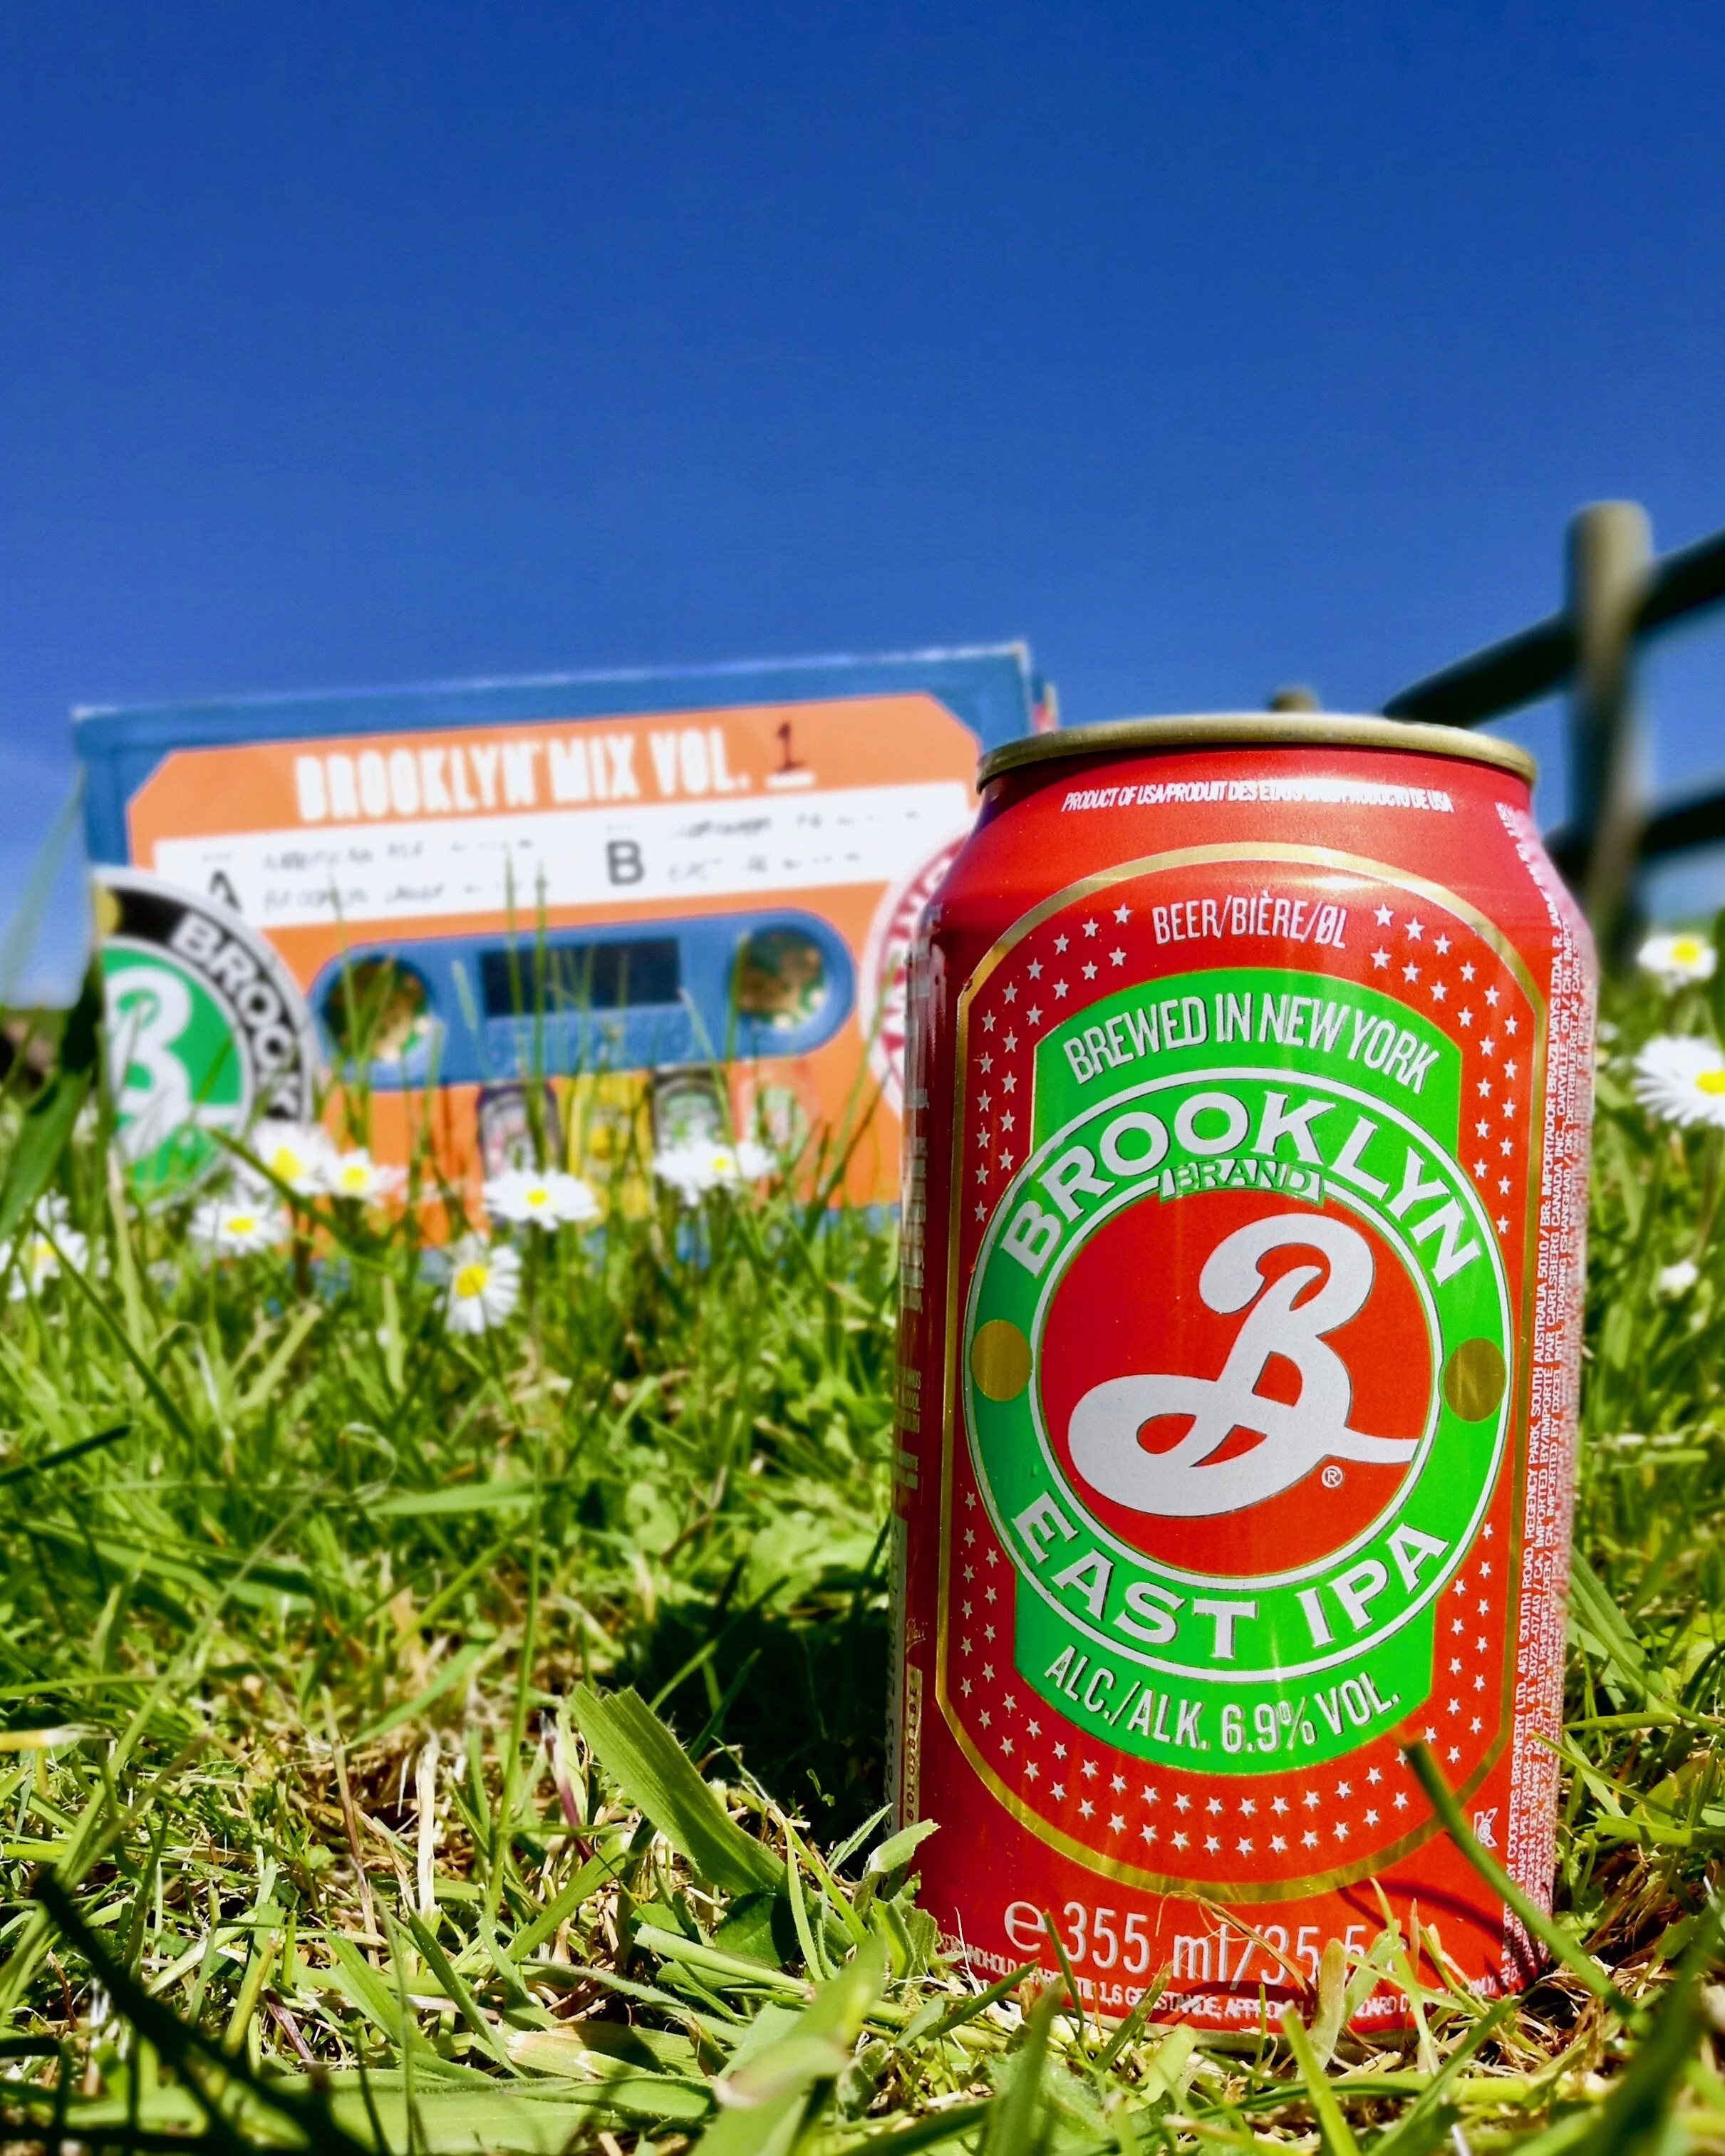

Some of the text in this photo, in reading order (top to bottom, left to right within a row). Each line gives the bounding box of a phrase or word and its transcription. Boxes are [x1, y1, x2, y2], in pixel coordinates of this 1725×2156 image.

[294, 738, 538, 822] BROOKLYN
[546, 731, 641, 805] MIX
[649, 725, 751, 797] VOL.
[1060, 787, 1120, 812] PRODUCT
[1118, 785, 1139, 807] OF
[605, 839, 644, 886] B
[1151, 889, 1347, 949] BEER/BIÈRE/ØL
[1062, 992, 1441, 1094] BREWED IN NEW YORK
[1560, 1008, 1571, 1034] ON
[1172, 1158, 1312, 1193] BRAND
[1541, 1097, 1557, 1196] IMPORTADOR
[999, 1089, 1483, 1288] BROOKLYN
[1551, 1161, 1564, 1227] CANADA
[1537, 1240, 1550, 1279] 5010
[1545, 1230, 1560, 1327] CARLSBERG
[1556, 1257, 1568, 1323] TRADING
[1533, 1282, 1548, 1364] AUSTRALIA
[1545, 1331, 1555, 1363] PAR
[1530, 1367, 1544, 1418] SOUTH
[1550, 1416, 1560, 1438] BY
[1528, 1420, 1543, 1465] PARK,
[1523, 1468, 1538, 1540] REGENCY
[1535, 1468, 1548, 1549] IMPORTED
[1546, 1441, 1558, 1517] IMPORTED
[1011, 1490, 1258, 1661] EAST
[1295, 1521, 1451, 1649] IPA
[1518, 1592, 1533, 1643] SOUTH
[1044, 1644, 1402, 1754] ALC./ALK. 6.9% VOL.
[1511, 1713, 1525, 1786] BREWERY
[1507, 1788, 1521, 1860] COOPERS
[1519, 1813, 1530, 1836] PR
[1062, 1901, 1150, 1975] 355
